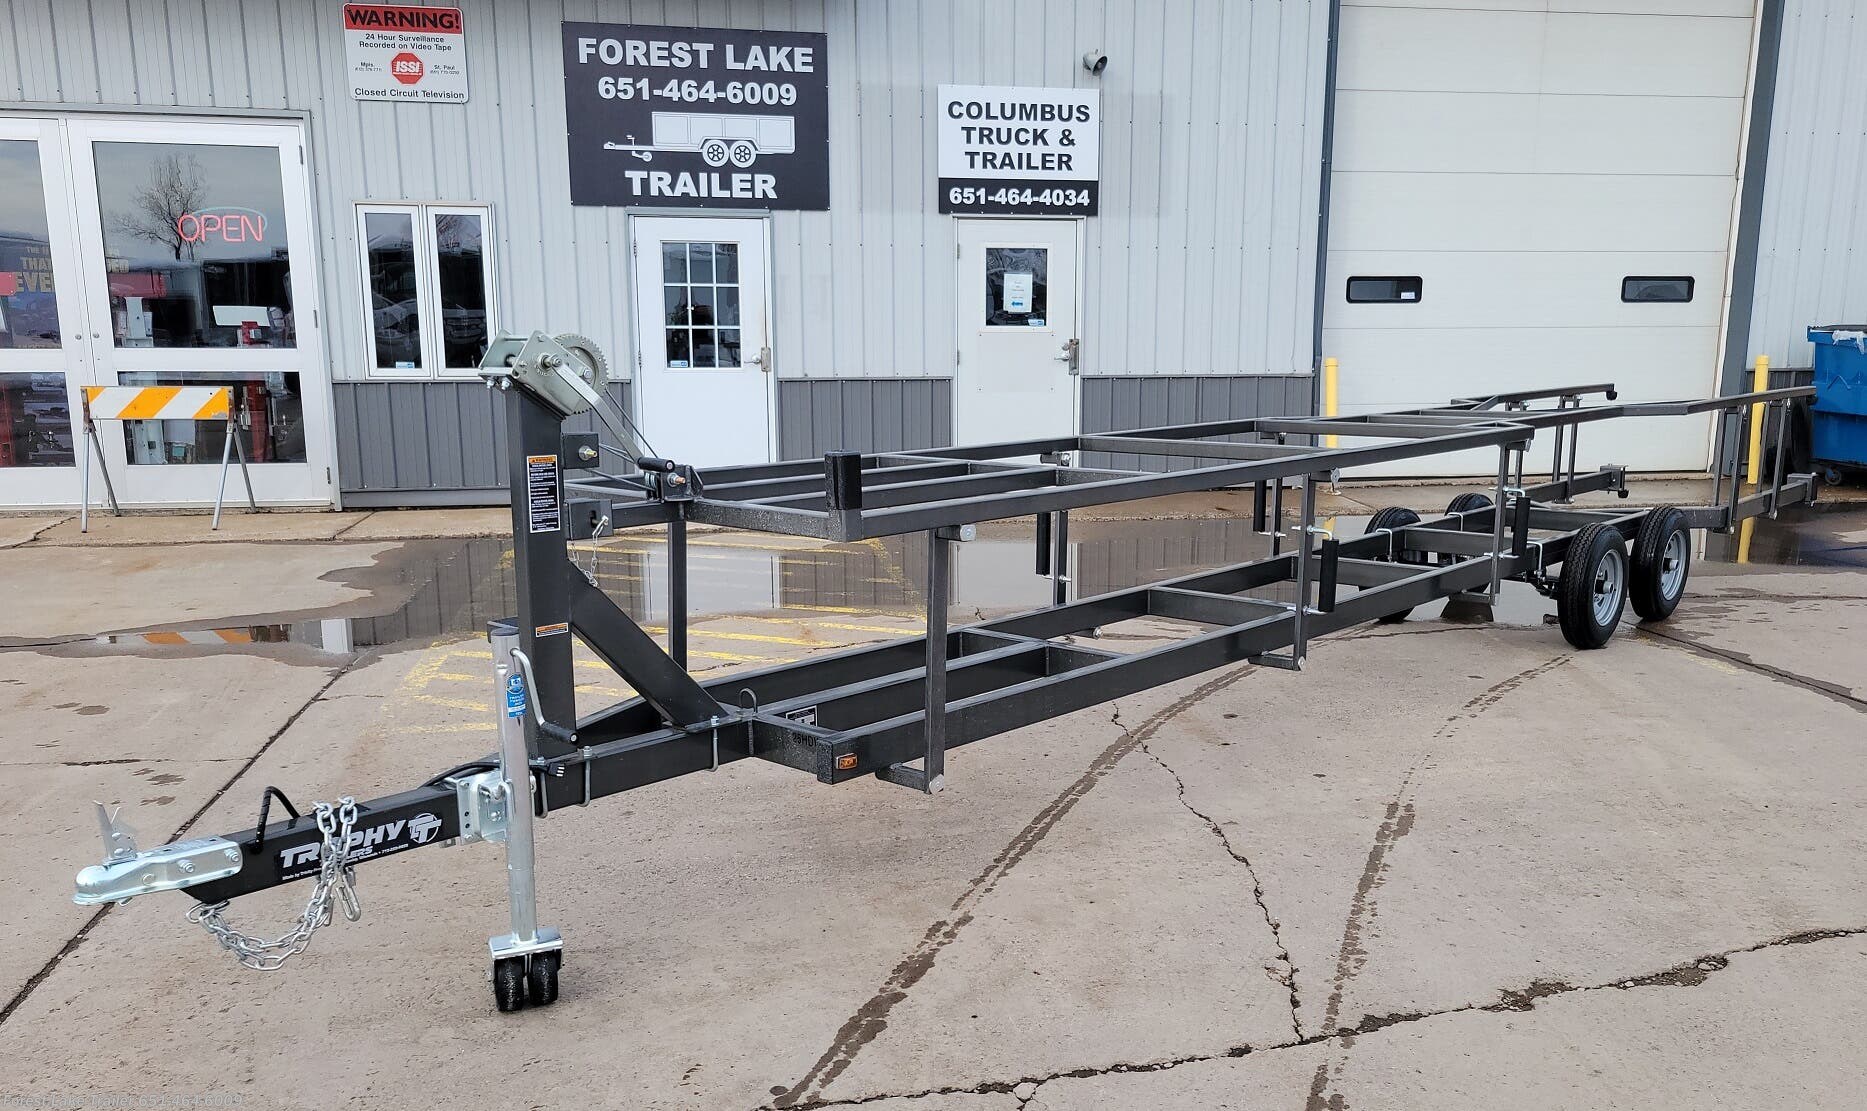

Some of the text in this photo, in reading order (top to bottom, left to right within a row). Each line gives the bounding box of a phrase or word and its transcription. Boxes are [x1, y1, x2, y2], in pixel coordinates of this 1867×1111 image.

[347, 9, 460, 30] WARNING!
[359, 40, 396, 49] Recorded
[410, 42, 432, 51] Video
[435, 43, 452, 53] Tape
[377, 33, 396, 41] Hour
[398, 34, 445, 43] Surveillance
[578, 37, 814, 73] FOREST LAKE
[354, 87, 465, 99] Closed Circuit Television
[598, 76, 797, 105] 651-464-6009
[948, 101, 1090, 123] COLUMBUS
[961, 126, 1076, 147] TRUCK &
[965, 151, 1073, 171] TRAILER
[625, 170, 778, 199] TRAILER
[949, 187, 1090, 206] 651-464-4034
[178, 214, 263, 242] OPEN
[15, 271, 55, 293] EVE
[280, 819, 406, 868] TRPHY
